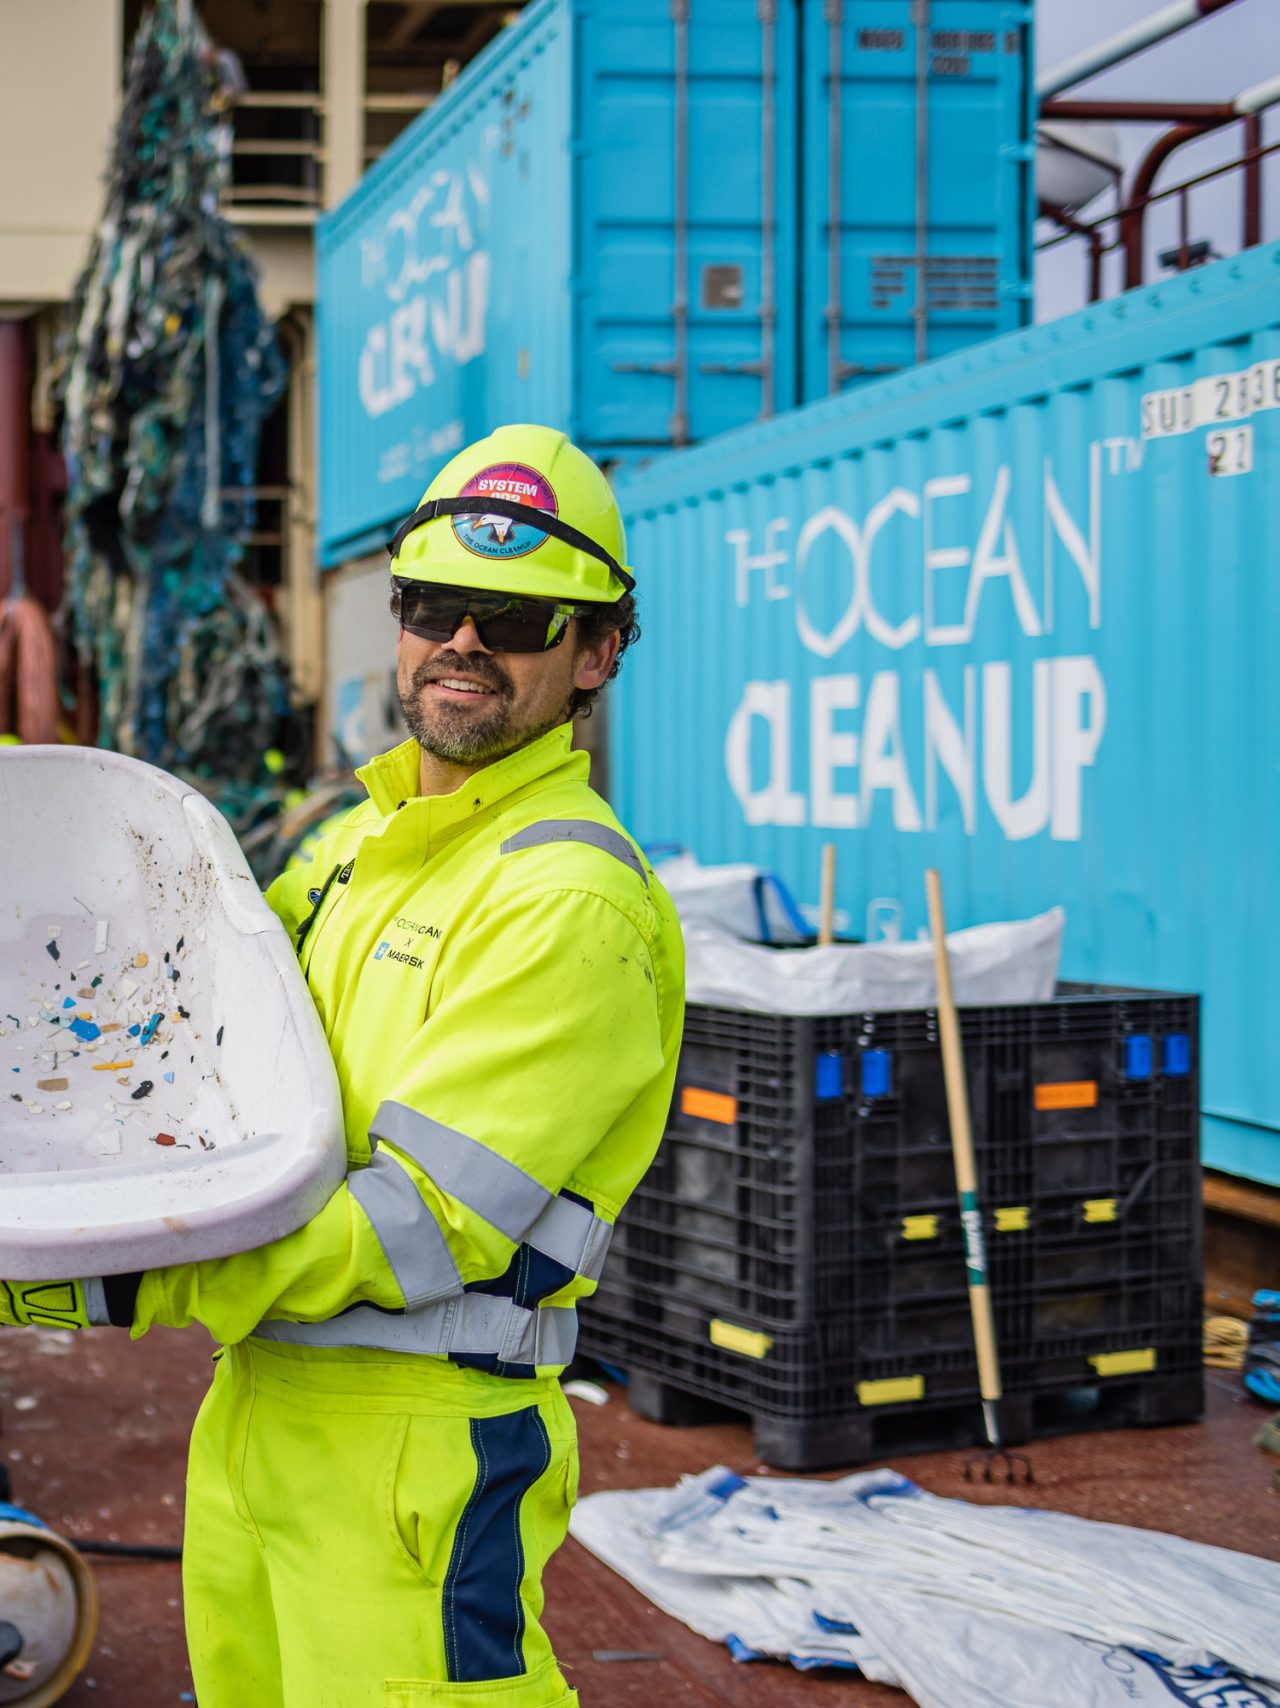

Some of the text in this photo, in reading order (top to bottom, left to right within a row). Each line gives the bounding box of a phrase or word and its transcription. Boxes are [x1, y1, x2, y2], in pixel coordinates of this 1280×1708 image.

[478, 480, 538, 497] SYSTEM
[463, 533, 532, 555] THE OCEAN CLEANUP
[724, 516, 791, 608] THE
[796, 441, 1102, 660] OCEAN
[724, 655, 1108, 842] CLEANUP
[403, 937, 414, 948] X
[387, 949, 426, 970] MAERSK
